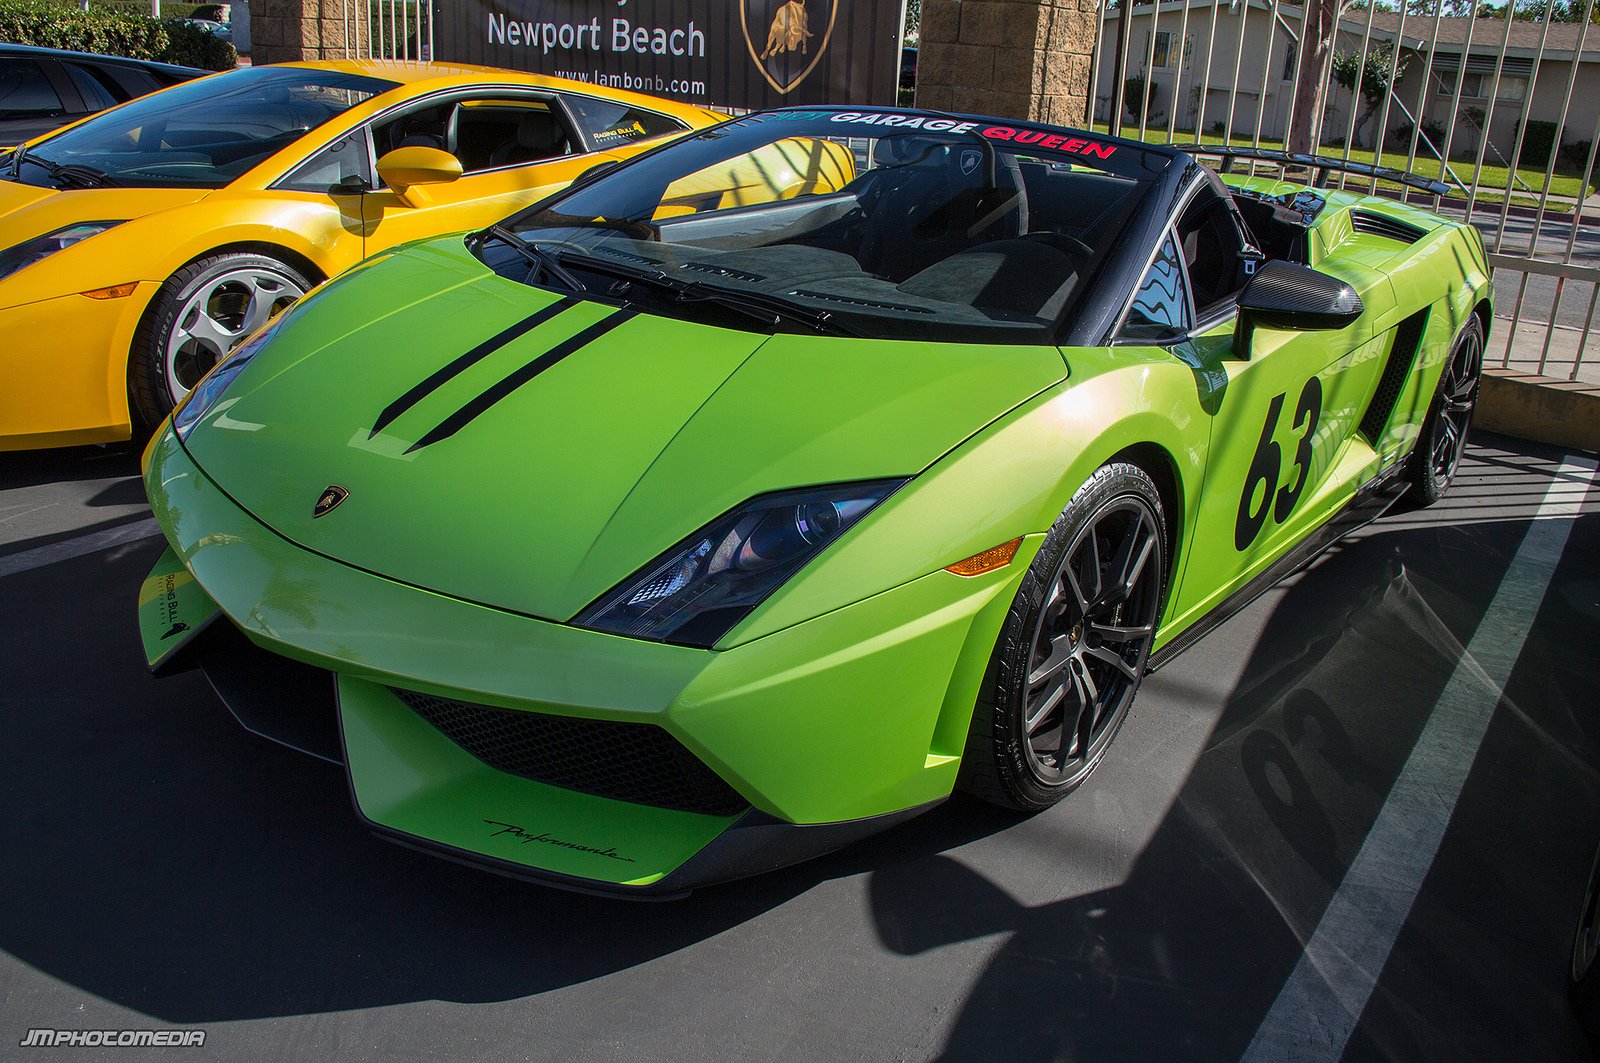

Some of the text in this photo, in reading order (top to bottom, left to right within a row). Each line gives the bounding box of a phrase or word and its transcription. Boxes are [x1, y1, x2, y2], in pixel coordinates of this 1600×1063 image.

[488, 12, 705, 57] Newport Beach
[554, 69, 705, 95] www.lambonb.com
[830, 112, 979, 135] GARAGE
[982, 127, 1118, 160] QUEEN
[1234, 375, 1323, 552] 63
